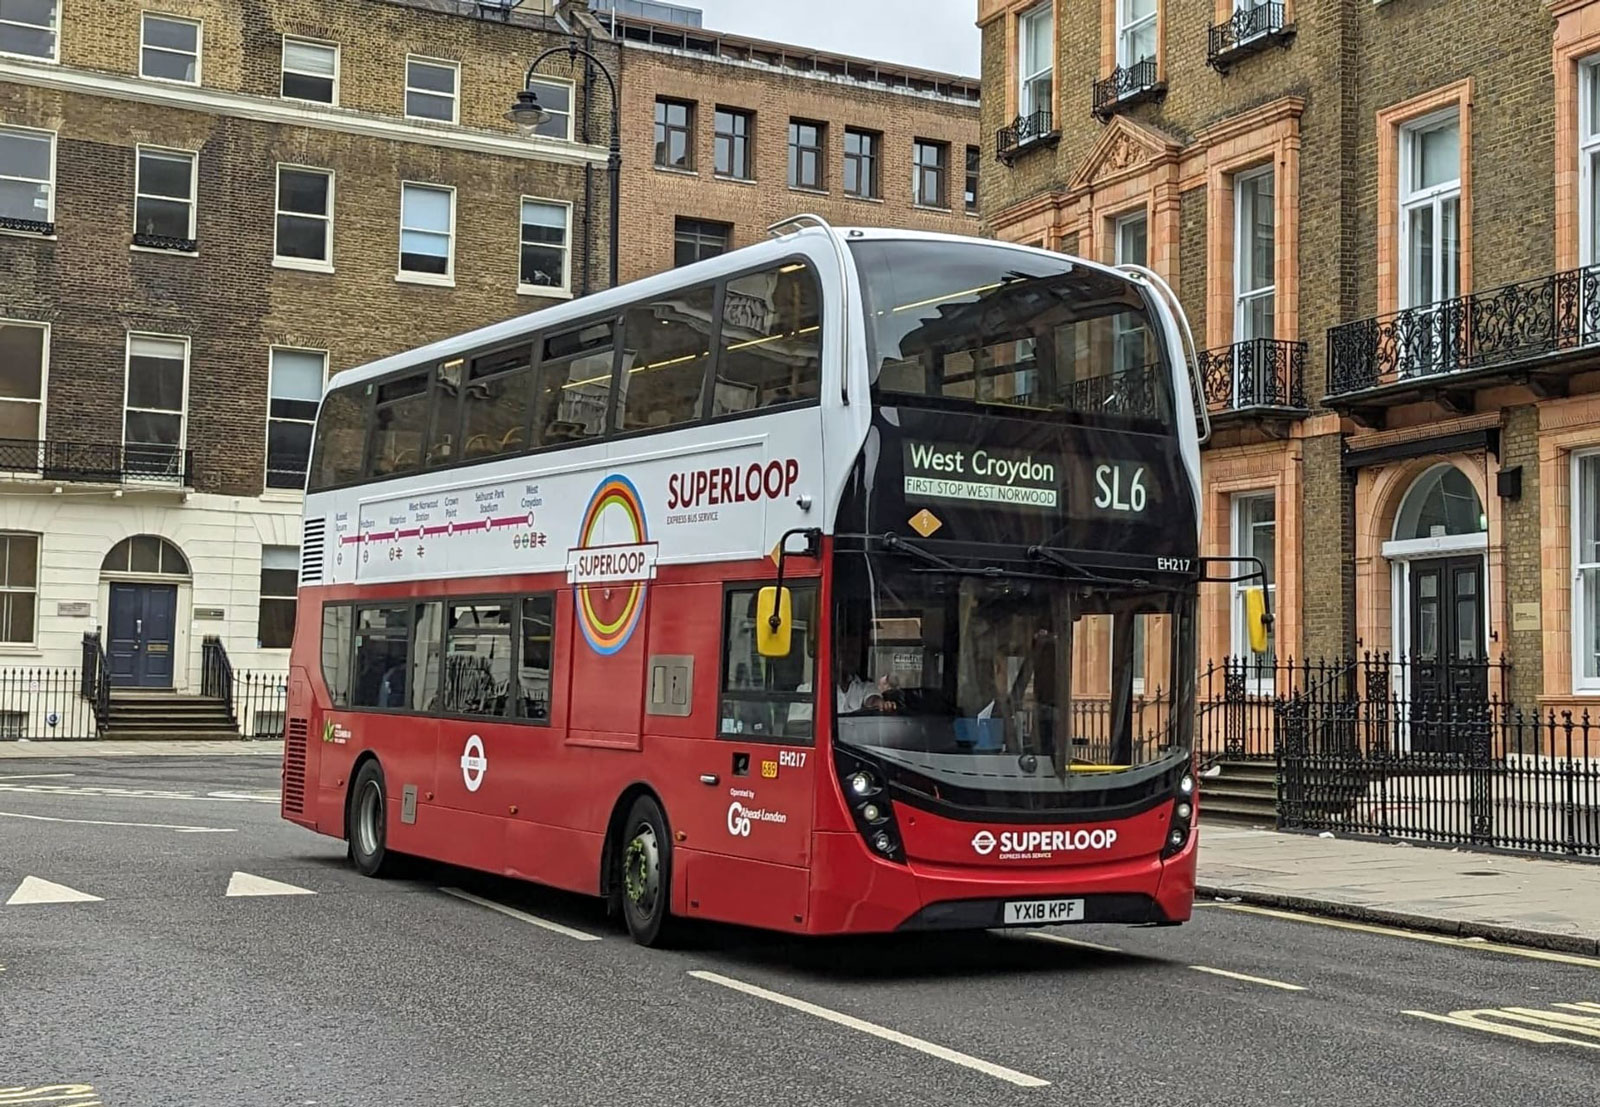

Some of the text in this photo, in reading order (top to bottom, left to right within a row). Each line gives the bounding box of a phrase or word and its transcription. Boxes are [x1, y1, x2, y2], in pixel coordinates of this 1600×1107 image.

[910, 443, 1054, 484] West Croydon
[667, 459, 799, 510] SUPERLOOP
[906, 478, 1055, 504] FIRST STOP WEST NORWOOD
[1094, 464, 1146, 512] SL6
[521, 498, 542, 508] Croydon
[666, 511, 718, 525] EXPRESS BUS SERVICE
[578, 552, 645, 577] SUPERLOOP
[1157, 557, 1191, 572] EH217
[779, 751, 806, 767] EH217
[728, 801, 751, 837] Go
[1000, 829, 1117, 852] SUPERLOOP
[1014, 902, 1076, 920] YX18 KPF
